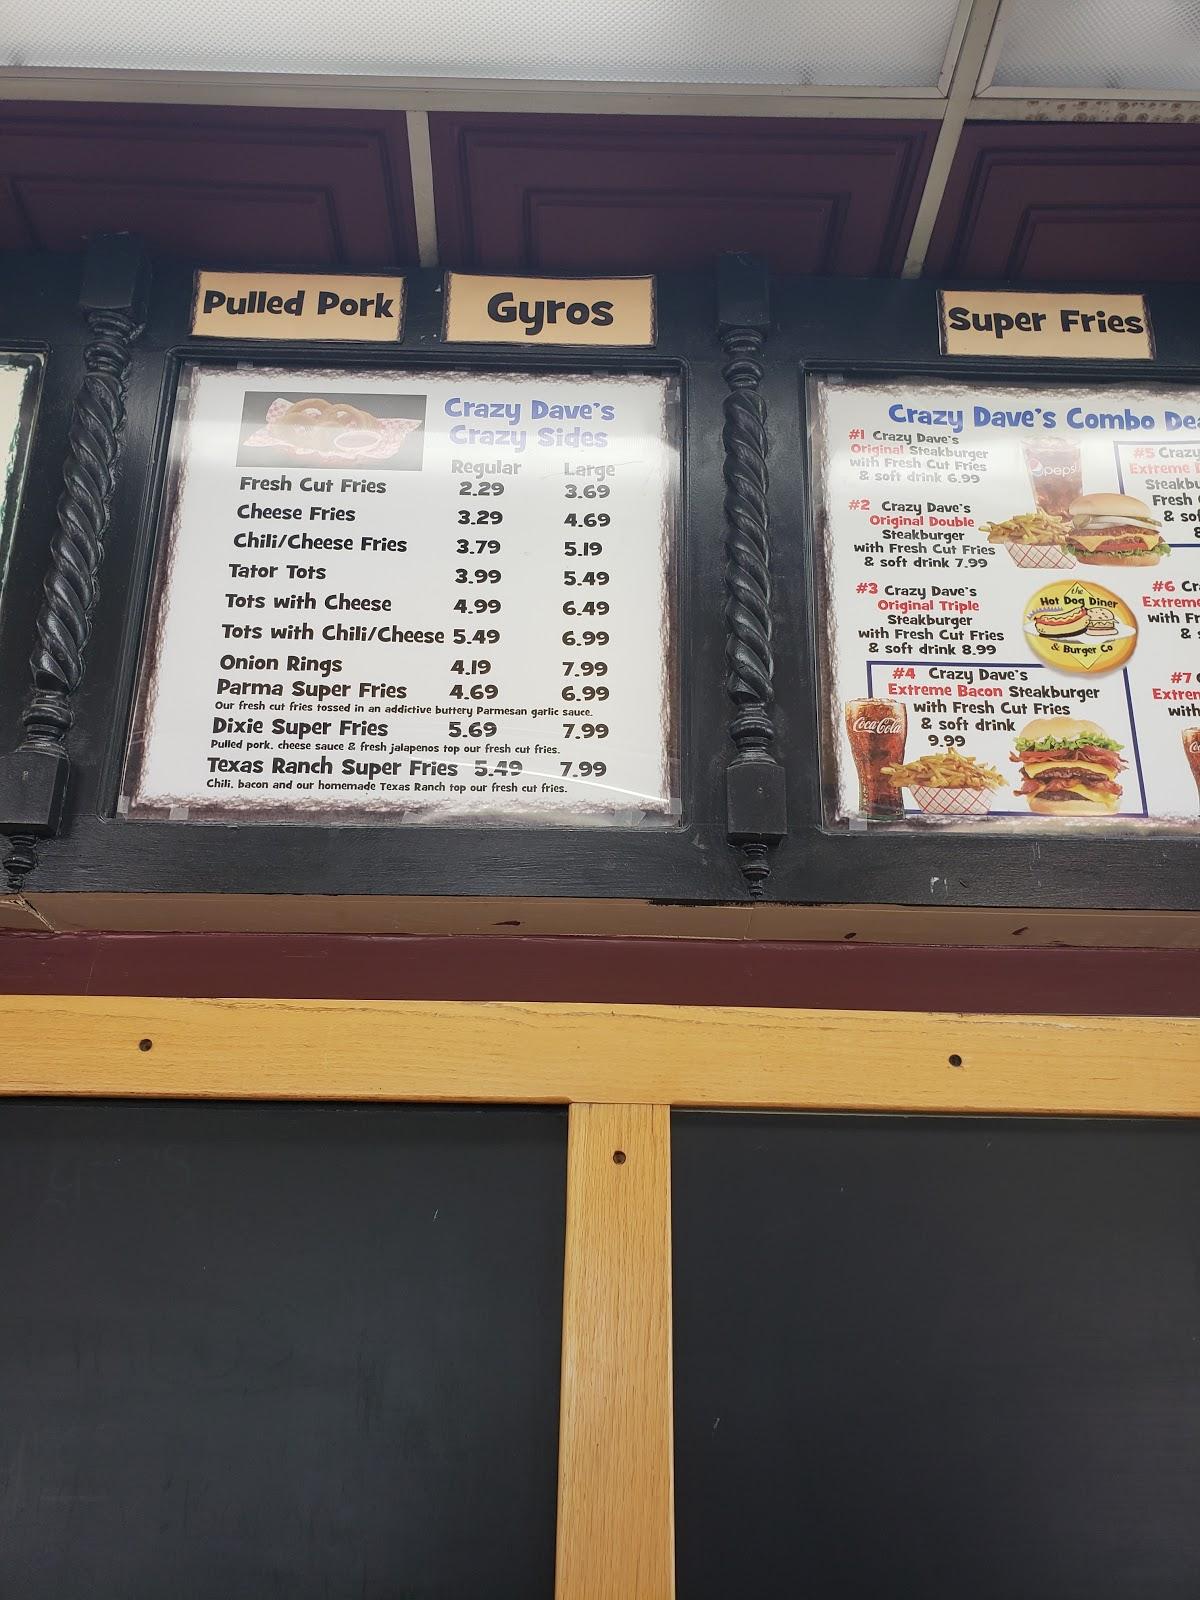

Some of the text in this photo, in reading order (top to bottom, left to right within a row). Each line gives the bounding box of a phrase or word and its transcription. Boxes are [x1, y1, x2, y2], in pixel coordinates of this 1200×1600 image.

[202, 289, 394, 318] Pulled Pork
[487, 291, 614, 335] Gyros
[948, 306, 1144, 338] Super Fries
[444, 397, 615, 425] Crazy Dave's
[888, 404, 1155, 433] Crazy Dave's Combo
[448, 424, 608, 452] Crazy Sides
[849, 429, 959, 445] #1 Crazy Dave's
[451, 459, 615, 482] Regular Large
[239, 474, 610, 499] Fresh Cut Fries 2.29 3.69
[848, 499, 971, 514] #2 Crazy Dave's
[236, 503, 610, 528] Cheese Fries 3.29 4.69
[869, 515, 974, 530] Original Double
[233, 531, 603, 557] Chili/Cheese Fries 3.79 5.19
[882, 529, 964, 544] Steakburger
[853, 540, 996, 555] with Fresh Cut Fries
[864, 555, 988, 568] & soft drink 7.99
[228, 563, 610, 586] Tator Tots 3.99 5.49
[855, 582, 977, 599] #3 Crazy Dave's
[224, 591, 609, 616] Tots with Cheese 4.99 6.49
[877, 599, 979, 614] Original Triple
[1039, 596, 1118, 608] Hot Dog Diner
[887, 614, 972, 629] Steakburger
[221, 622, 609, 646] Tots with Chili/Cheese 5.49 6.99
[858, 626, 1004, 641] with Fresh Cut Fries
[868, 642, 996, 656] & soft drink 8.99
[1050, 643, 1113, 657] & Burger Co
[219, 654, 608, 677] Onion Rings 4.19 7.99
[892, 667, 1028, 684] #4 Crazy Dave's
[215, 677, 610, 701] Parma Super Fries 4.69 6.99
[887, 683, 1100, 702] Extreme Bacon Steakburger
[215, 701, 593, 718] Our fresh cut fries tossed in an addictive buttery Parmesan garlic sauce.
[913, 698, 1070, 716] with Fresh Cut Fries
[212, 716, 609, 739] Dixie Super Fries 5.69 7.99
[920, 717, 1016, 732] & soft drink
[211, 739, 242, 749] Pulled
[277, 741, 311, 750] cheese
[314, 742, 344, 751] sauce
[347, 742, 356, 751] &
[360, 741, 386, 751] fresh
[388, 741, 439, 754] jalapenos
[443, 744, 460, 755] top
[463, 744, 480, 753] our
[485, 744, 511, 754] fresh
[514, 745, 530, 754] cut
[534, 744, 560, 754] fries.
[928, 734, 966, 748] 9.99
[207, 754, 607, 780] Texas Ranch Super Fries 5.49 7.99
[237, 779, 268, 789] bacon
[272, 780, 292, 789] and
[296, 781, 314, 790] our
[318, 780, 375, 791] homemade
[379, 782, 410, 791] Texas
[414, 780, 445, 791] Ranch
[449, 783, 466, 794] top
[470, 783, 487, 792] our
[491, 783, 518, 792] fresh
[521, 784, 537, 792] cut
[541, 783, 567, 793] fries.
